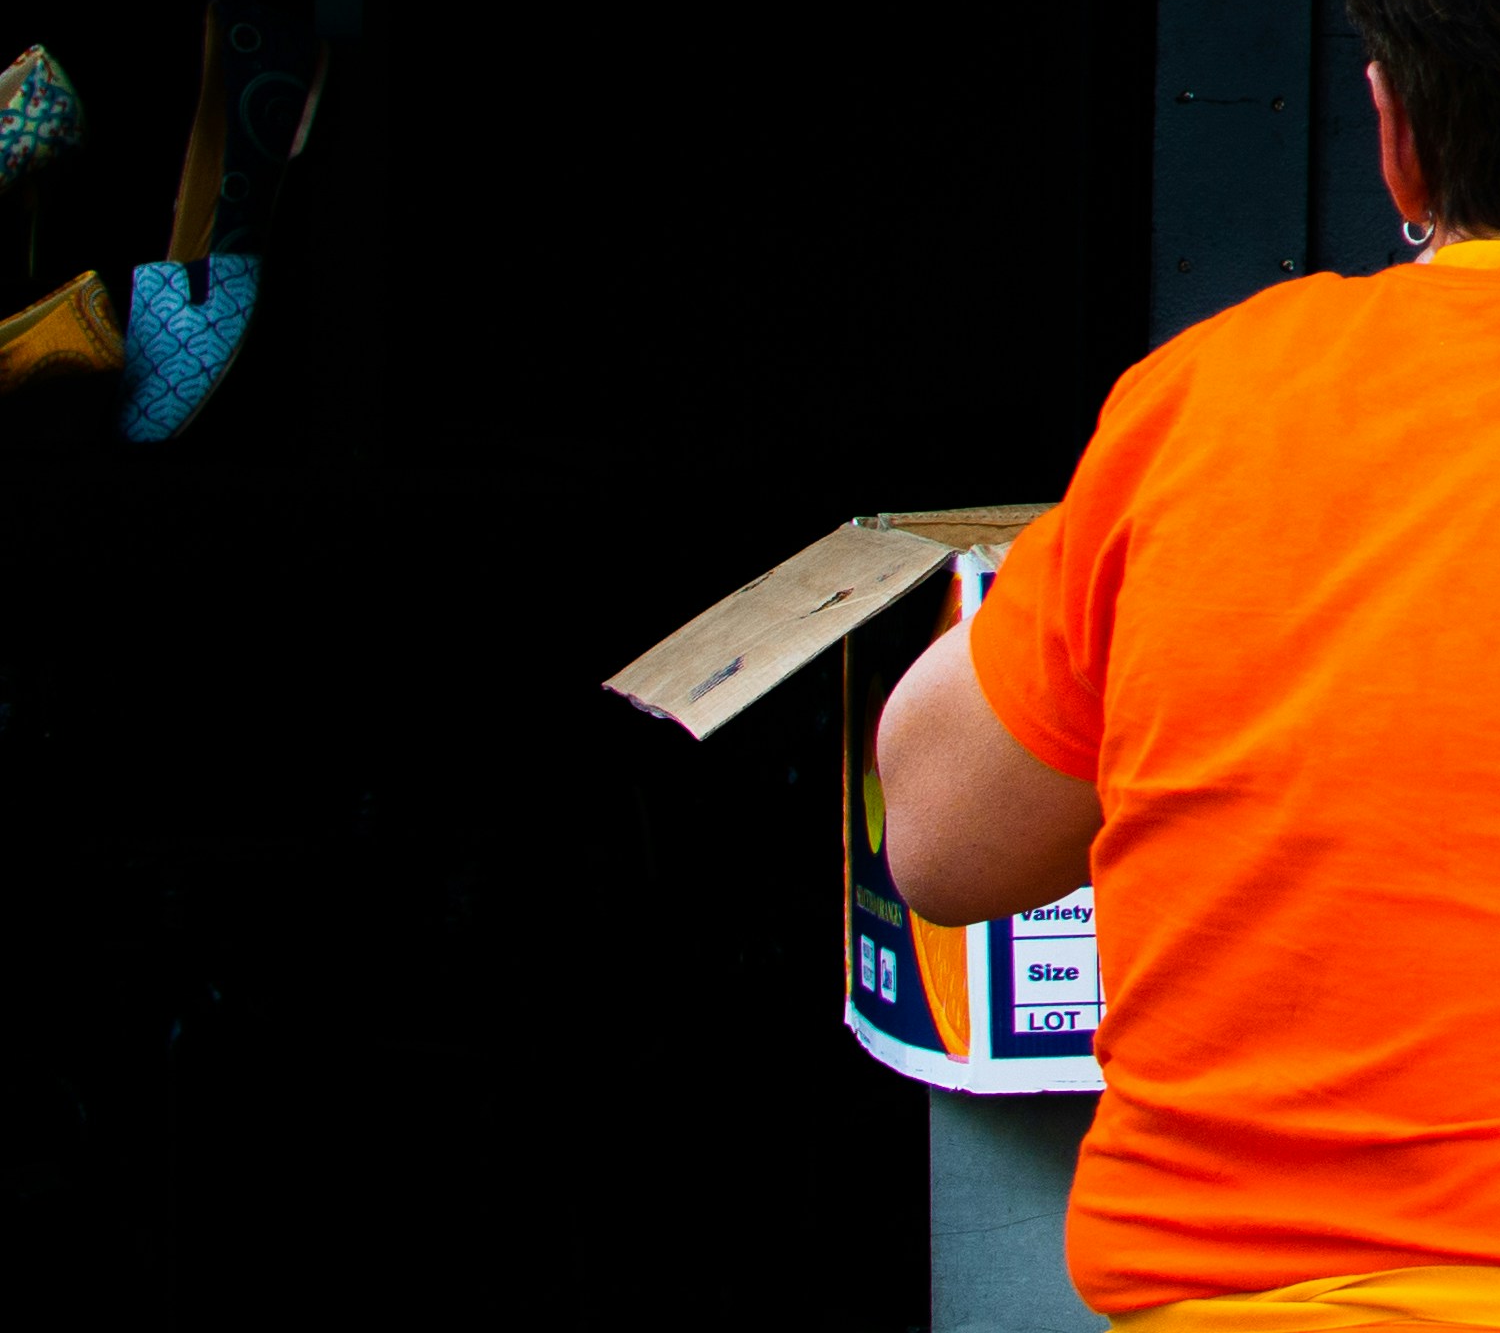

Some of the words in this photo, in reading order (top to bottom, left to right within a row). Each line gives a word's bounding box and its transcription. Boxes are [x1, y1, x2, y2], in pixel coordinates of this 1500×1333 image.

[1021, 905, 1093, 923] Variety
[1028, 963, 1079, 981] Size
[1029, 1011, 1081, 1031] LOT
